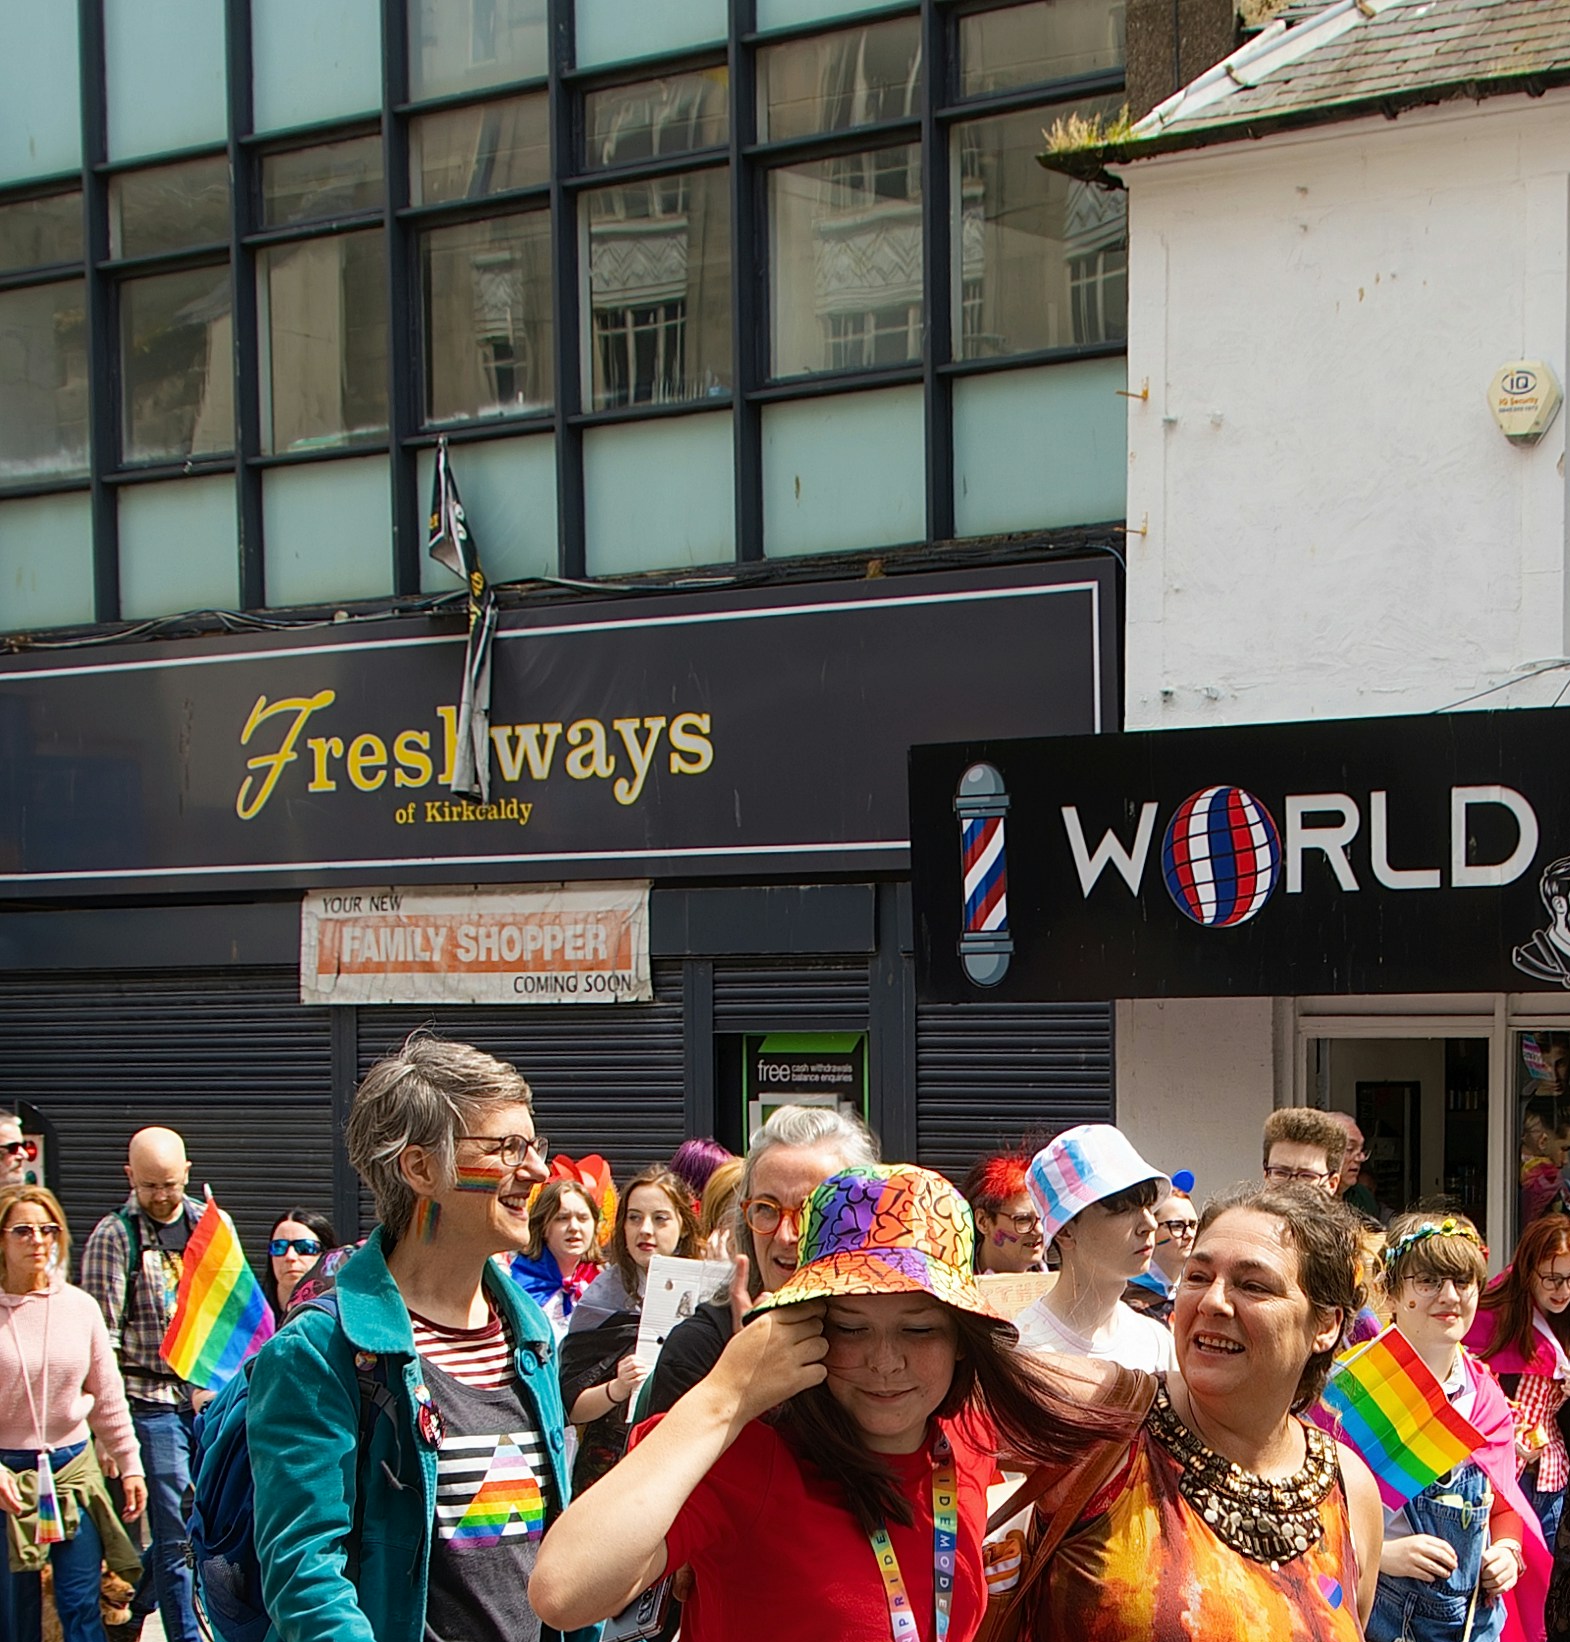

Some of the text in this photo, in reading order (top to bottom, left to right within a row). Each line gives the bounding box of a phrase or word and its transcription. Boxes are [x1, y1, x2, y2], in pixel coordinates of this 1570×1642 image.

[395, 799, 533, 826] of Kirkcaldy
[322, 894, 404, 915] YOUR NEW
[342, 923, 607, 964] FAMILY SHOPPER
[513, 973, 633, 994] COMING SOON
[757, 1059, 791, 1082] free
[791, 1063, 853, 1073] cash withdrawals
[791, 1073, 853, 1084] balance enquiries
